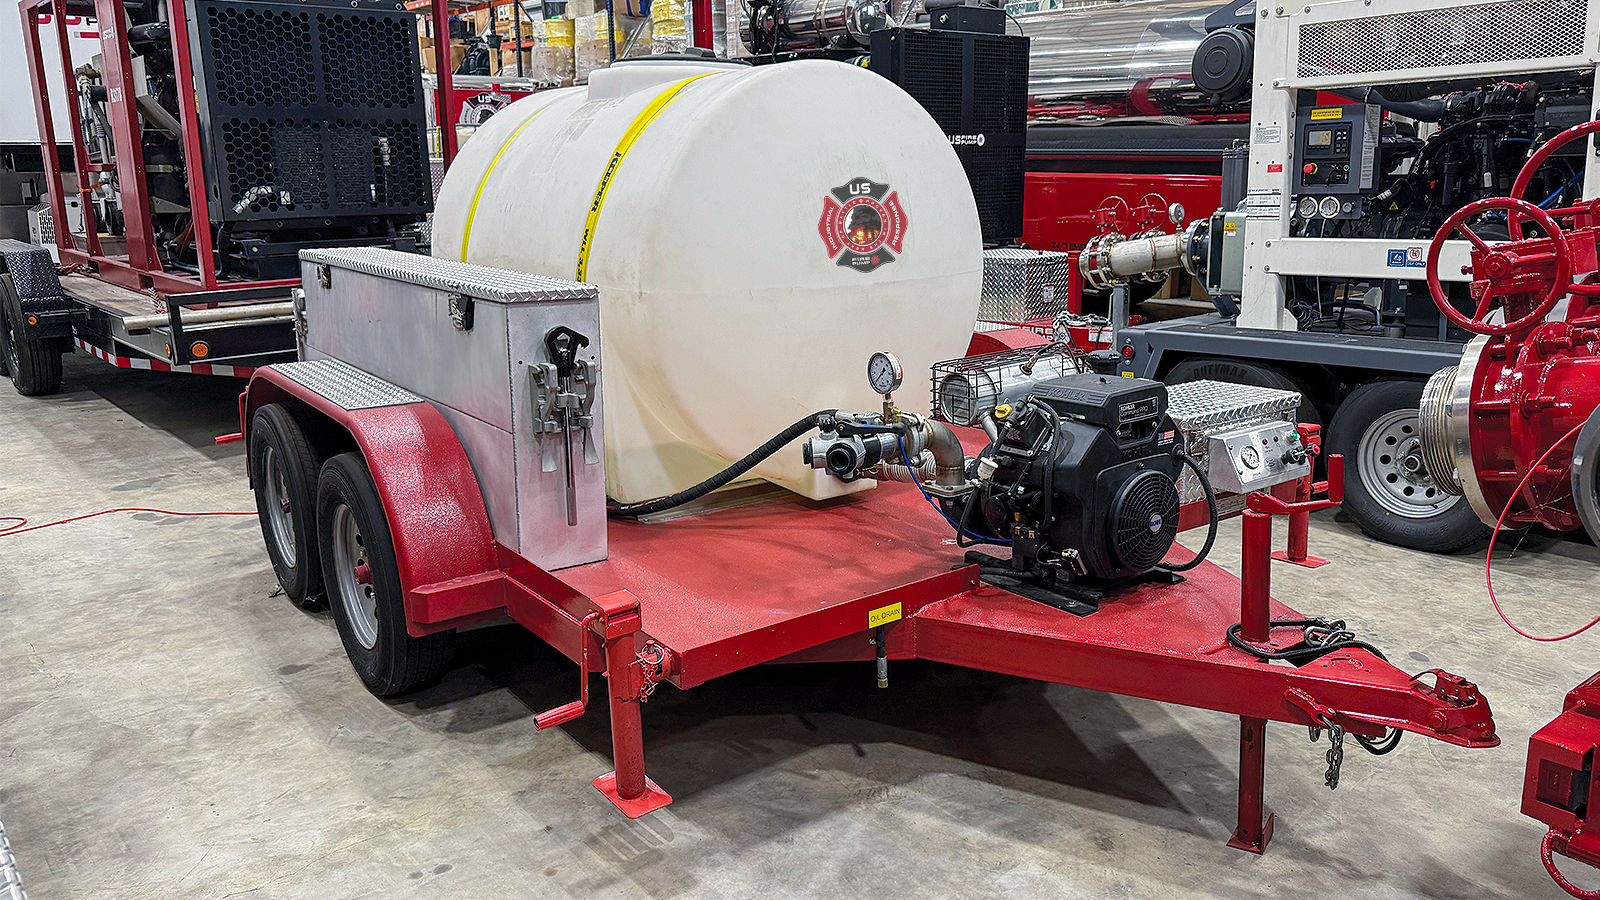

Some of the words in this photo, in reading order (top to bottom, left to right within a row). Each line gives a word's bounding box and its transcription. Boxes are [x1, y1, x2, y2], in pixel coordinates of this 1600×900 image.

[478, 95, 492, 103] US
[849, 183, 871, 195] US
[826, 206, 838, 251] INDUSTRIAL
[888, 200, 901, 246] RESPONSE
[1051, 241, 1068, 249] 24/7
[1193, 363, 1248, 379] DUTYMAX
[1046, 387, 1085, 401] KOHLER
[881, 608, 900, 619] DRAIN
